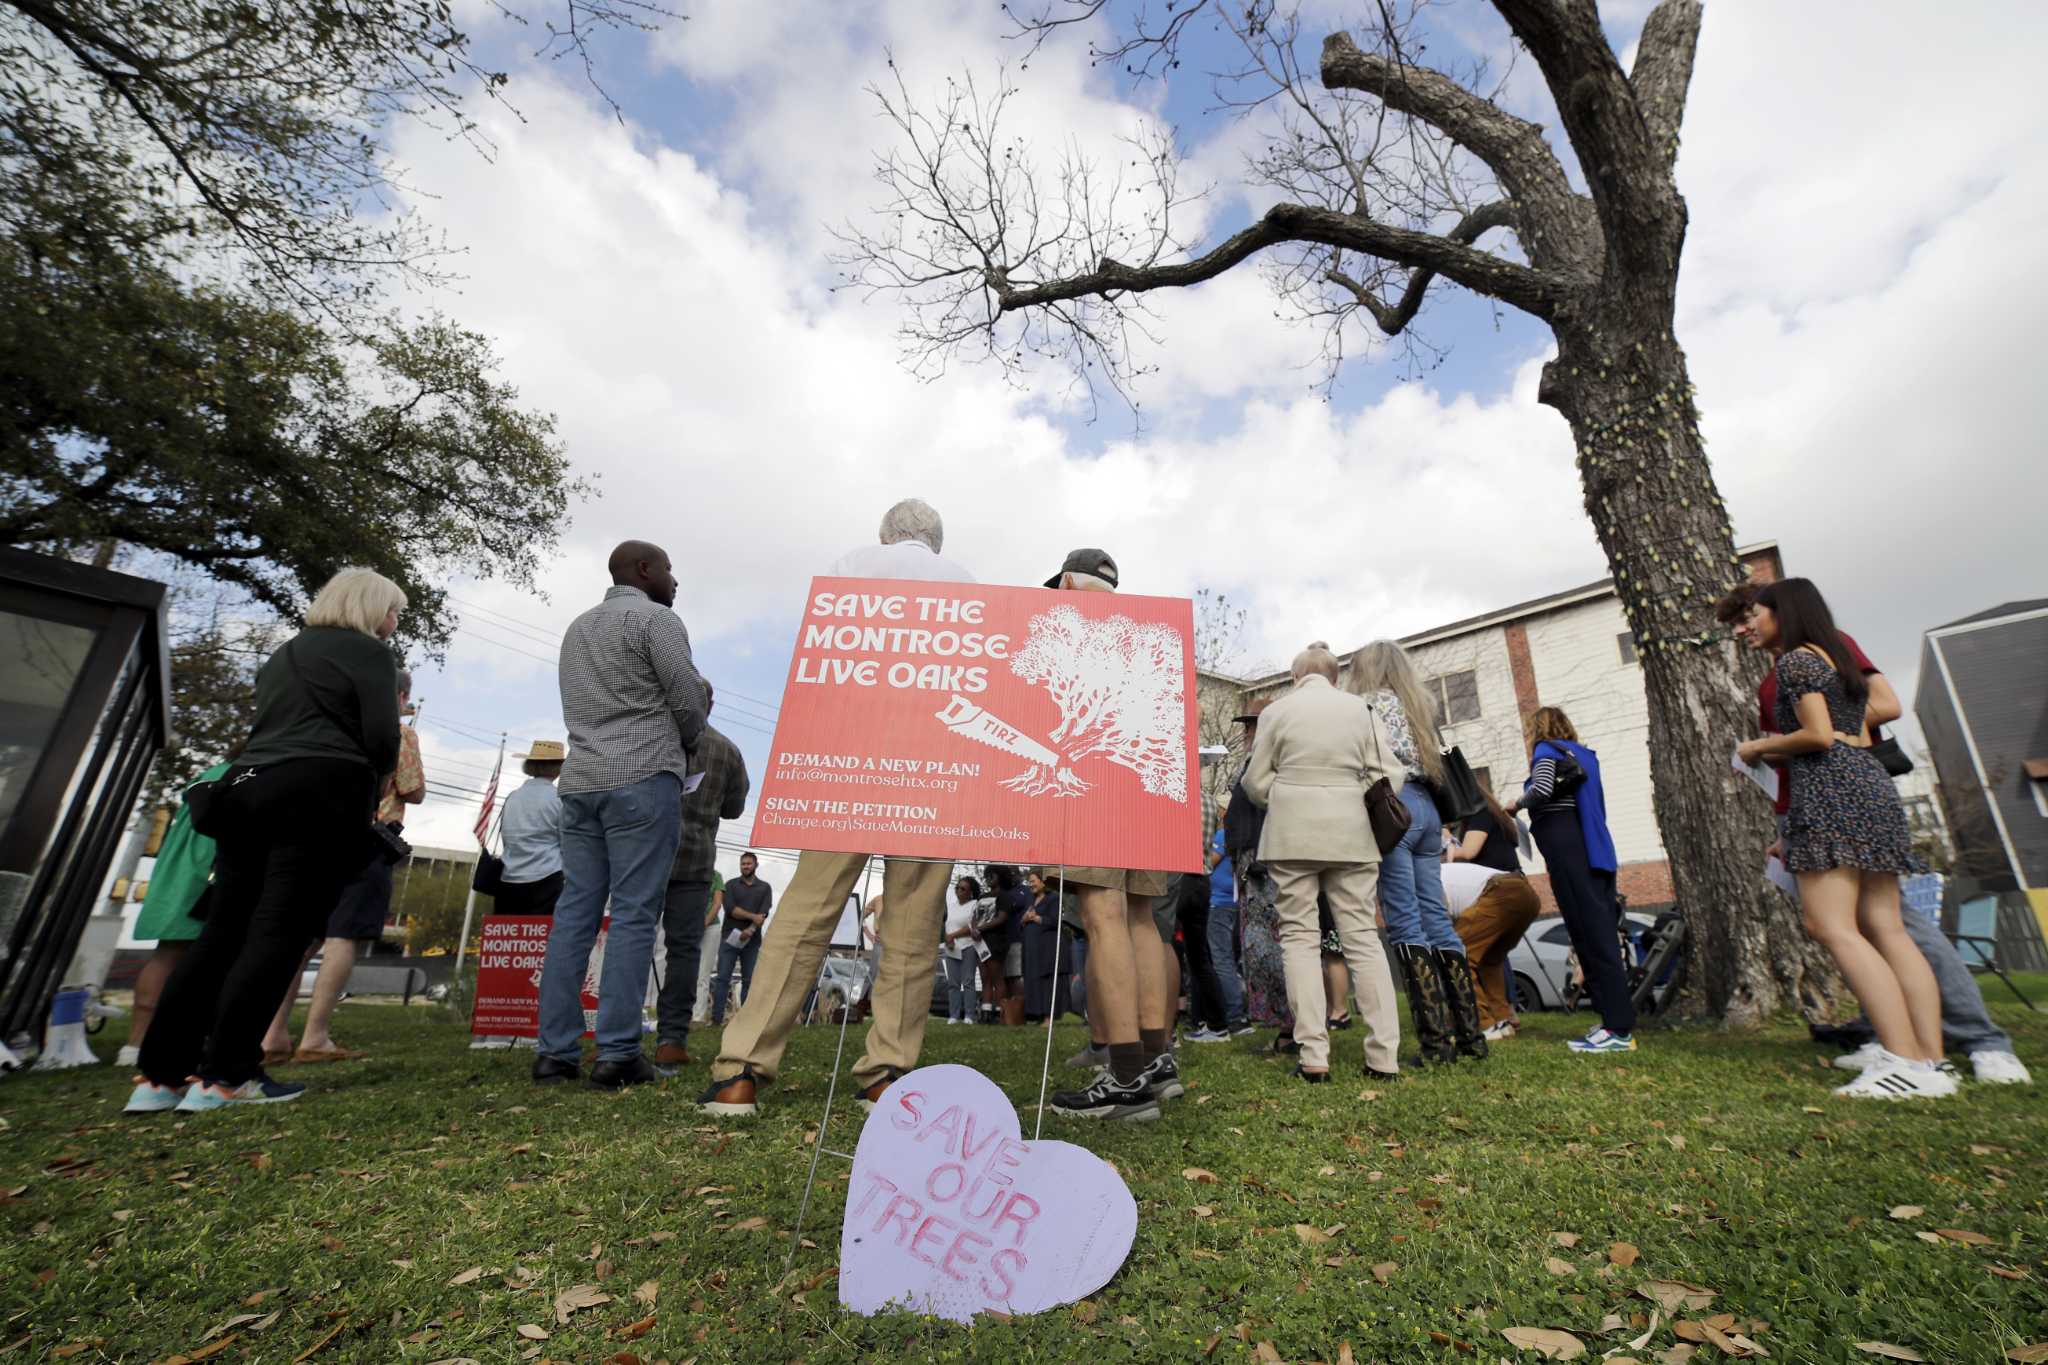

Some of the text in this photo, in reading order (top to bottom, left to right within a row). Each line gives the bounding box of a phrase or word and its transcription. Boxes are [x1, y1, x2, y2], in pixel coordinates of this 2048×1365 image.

[811, 592, 986, 624] SAVE THE
[803, 624, 1011, 659] MONTROSE
[795, 658, 989, 693] LIVE OAKS
[983, 719, 1019, 746] TIRZ
[779, 752, 981, 777] DEMAND A NEW PLAN!
[776, 768, 958, 792] info@montrosehtx.org
[765, 797, 937, 820] SIGN THE PETITION
[484, 924, 548, 936] SAVE THE
[482, 940, 547, 952] MONTROS
[481, 956, 510, 968] LIVE
[526, 998, 539, 1006] PLA
[1088, 1084, 1106, 1103] N
[891, 1090, 1032, 1186] SAVE
[927, 1162, 1041, 1247] OUR
[854, 1171, 1028, 1302] TREES
